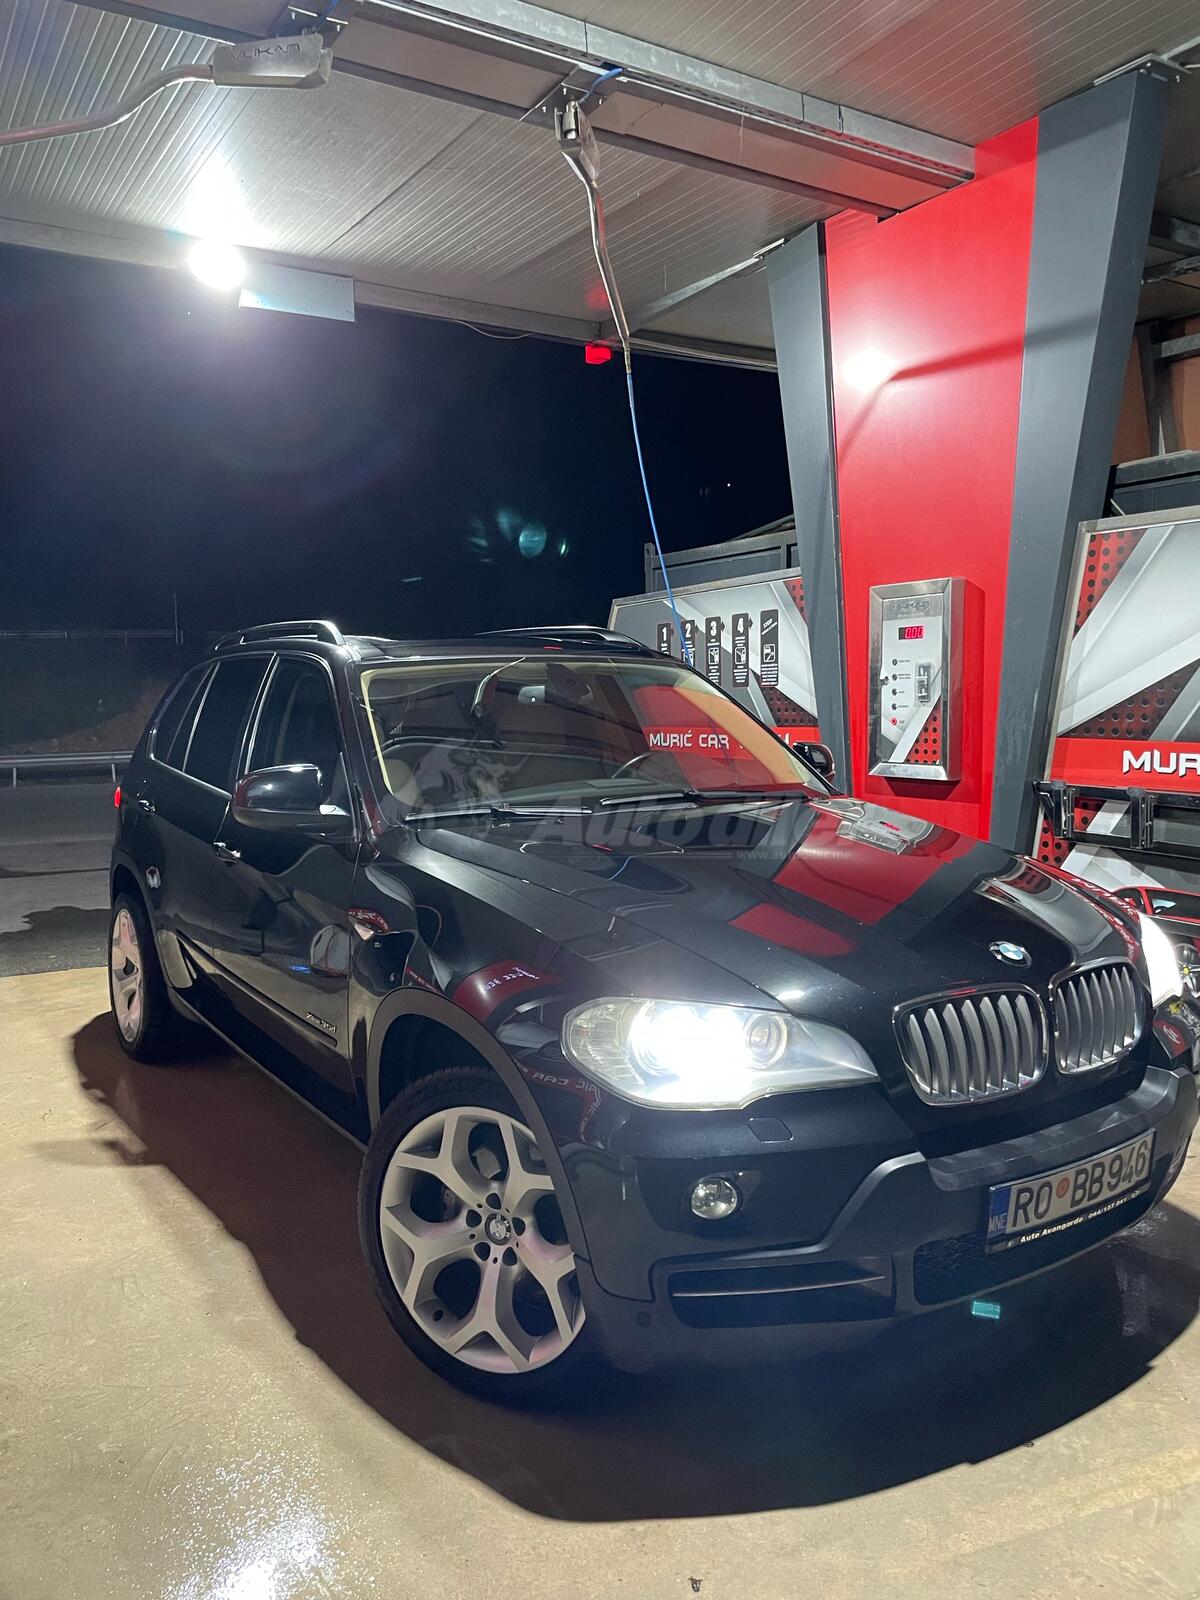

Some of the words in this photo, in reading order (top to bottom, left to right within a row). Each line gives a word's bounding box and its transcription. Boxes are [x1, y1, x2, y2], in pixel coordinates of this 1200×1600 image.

[661, 626, 667, 642] 1
[685, 623, 691, 638] 2
[710, 621, 717, 636] 3
[737, 617, 744, 633] 4
[649, 730, 693, 749] MURIĆ
[699, 734, 729, 750] CAR
[1011, 1181, 1053, 1228] RO
[1070, 1139, 1149, 1209] BB946
[988, 1212, 1008, 1233] MNE
[1020, 1230, 1040, 1244] Auto
[1041, 1215, 1084, 1237] Avangarde
